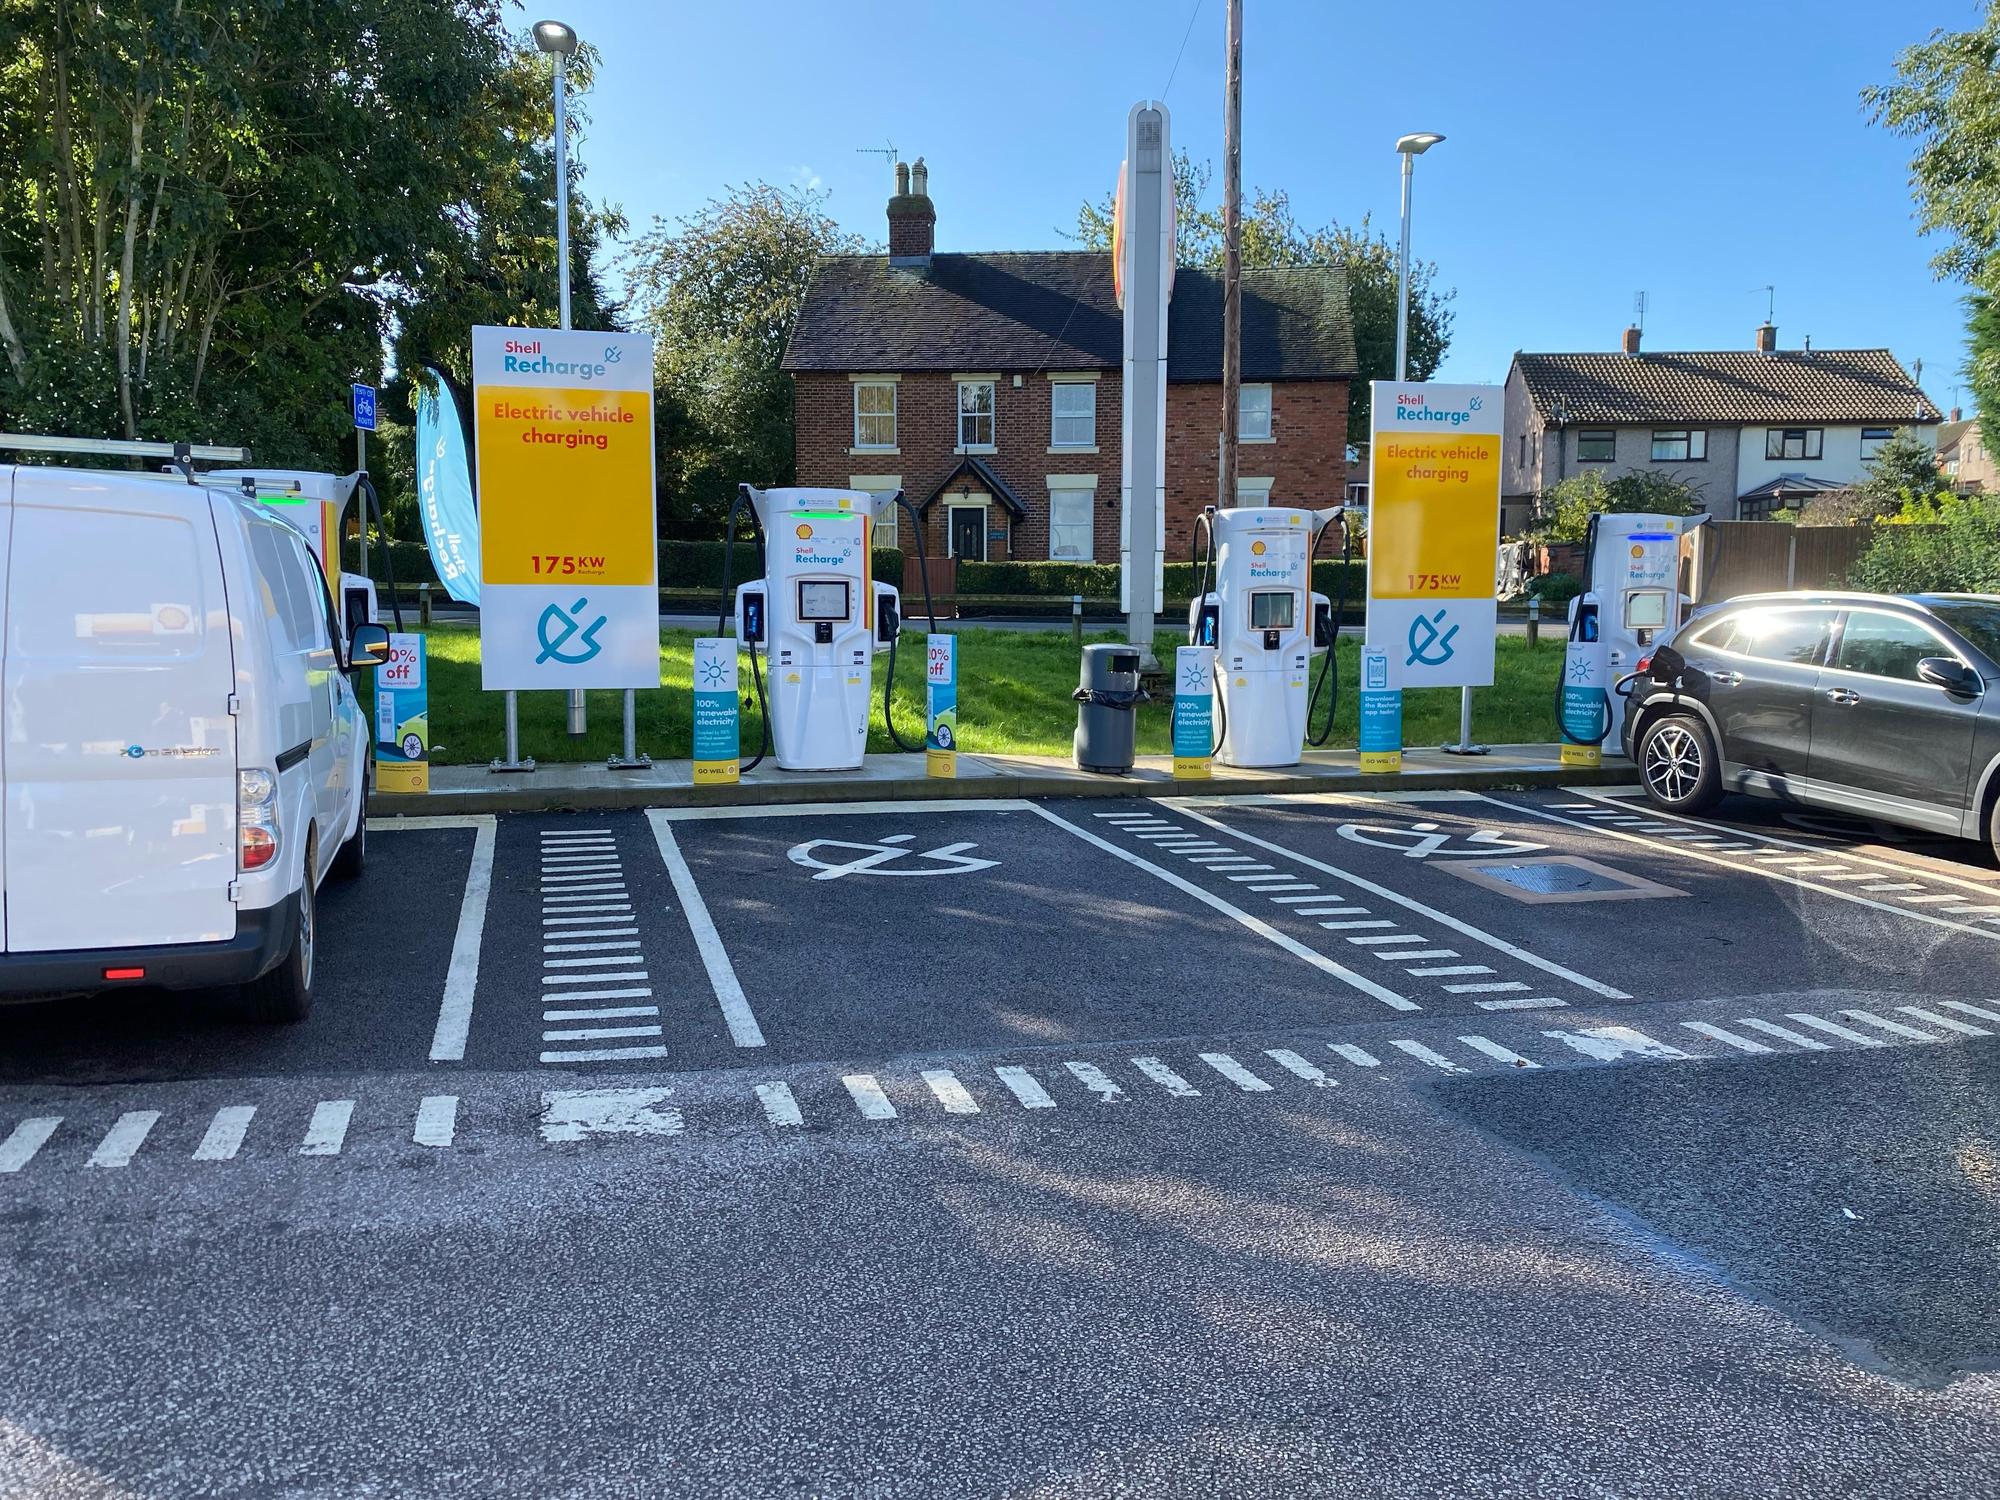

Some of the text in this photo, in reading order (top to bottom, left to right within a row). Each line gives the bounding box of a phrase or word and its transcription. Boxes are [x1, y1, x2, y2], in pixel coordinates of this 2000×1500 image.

[505, 341, 541, 354] Shell
[505, 356, 606, 380] Recharge
[1398, 395, 1424, 405] Shell
[494, 403, 634, 423] Electric vehicle
[1397, 406, 1470, 425] Recharge
[358, 417, 373, 426] ROUTE
[522, 427, 608, 449] charging
[1387, 444, 1489, 460] Electric vehicle
[1407, 465, 1469, 483] charging
[532, 556, 606, 574] 175 KW
[796, 555, 844, 565] Recharge
[1251, 568, 1292, 579] Recharge
[1630, 571, 1665, 581] Recharge
[1408, 575, 1461, 590] 175 KW
[387, 665, 410, 679] off
[930, 663, 944, 675] off
[697, 700, 720, 708] 100%
[1178, 702, 1199, 710] 100%
[1566, 701, 1603, 709] renewable
[1566, 709, 1597, 718] electricity
[697, 717, 735, 727] electricity
[1178, 718, 1211, 727] electricity
